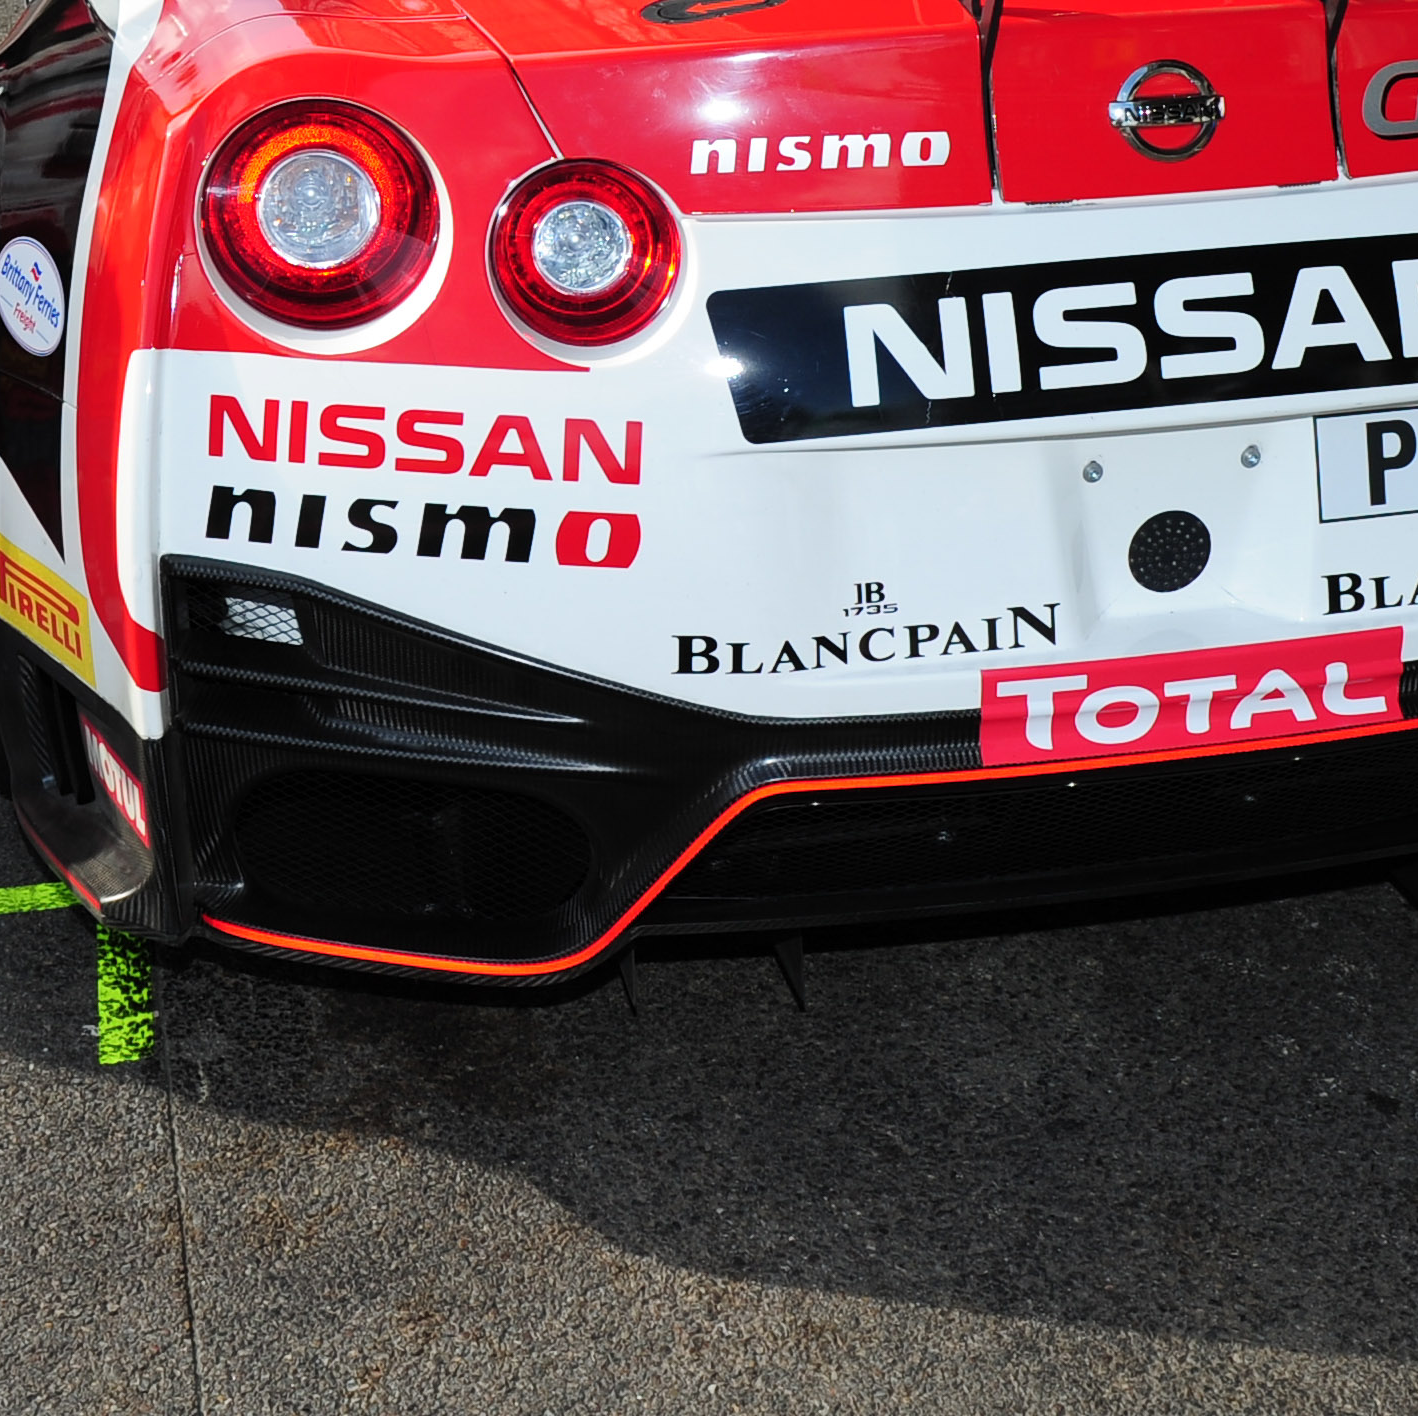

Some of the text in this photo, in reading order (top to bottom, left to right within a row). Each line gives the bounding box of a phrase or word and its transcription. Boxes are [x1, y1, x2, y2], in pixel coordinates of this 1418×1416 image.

[1124, 103, 1222, 123] NISSAN
[689, 130, 952, 176] nismo
[1, 254, 61, 329] Brittany Ferries
[12, 301, 38, 334] Freight
[208, 395, 643, 484] NISSAN
[206, 485, 641, 568] nismo
[671, 602, 1062, 676] BLANCPAIN
[841, 602, 899, 617] 1735
[995, 660, 1389, 751] TOTAL
[84, 724, 145, 837] MOTUL
